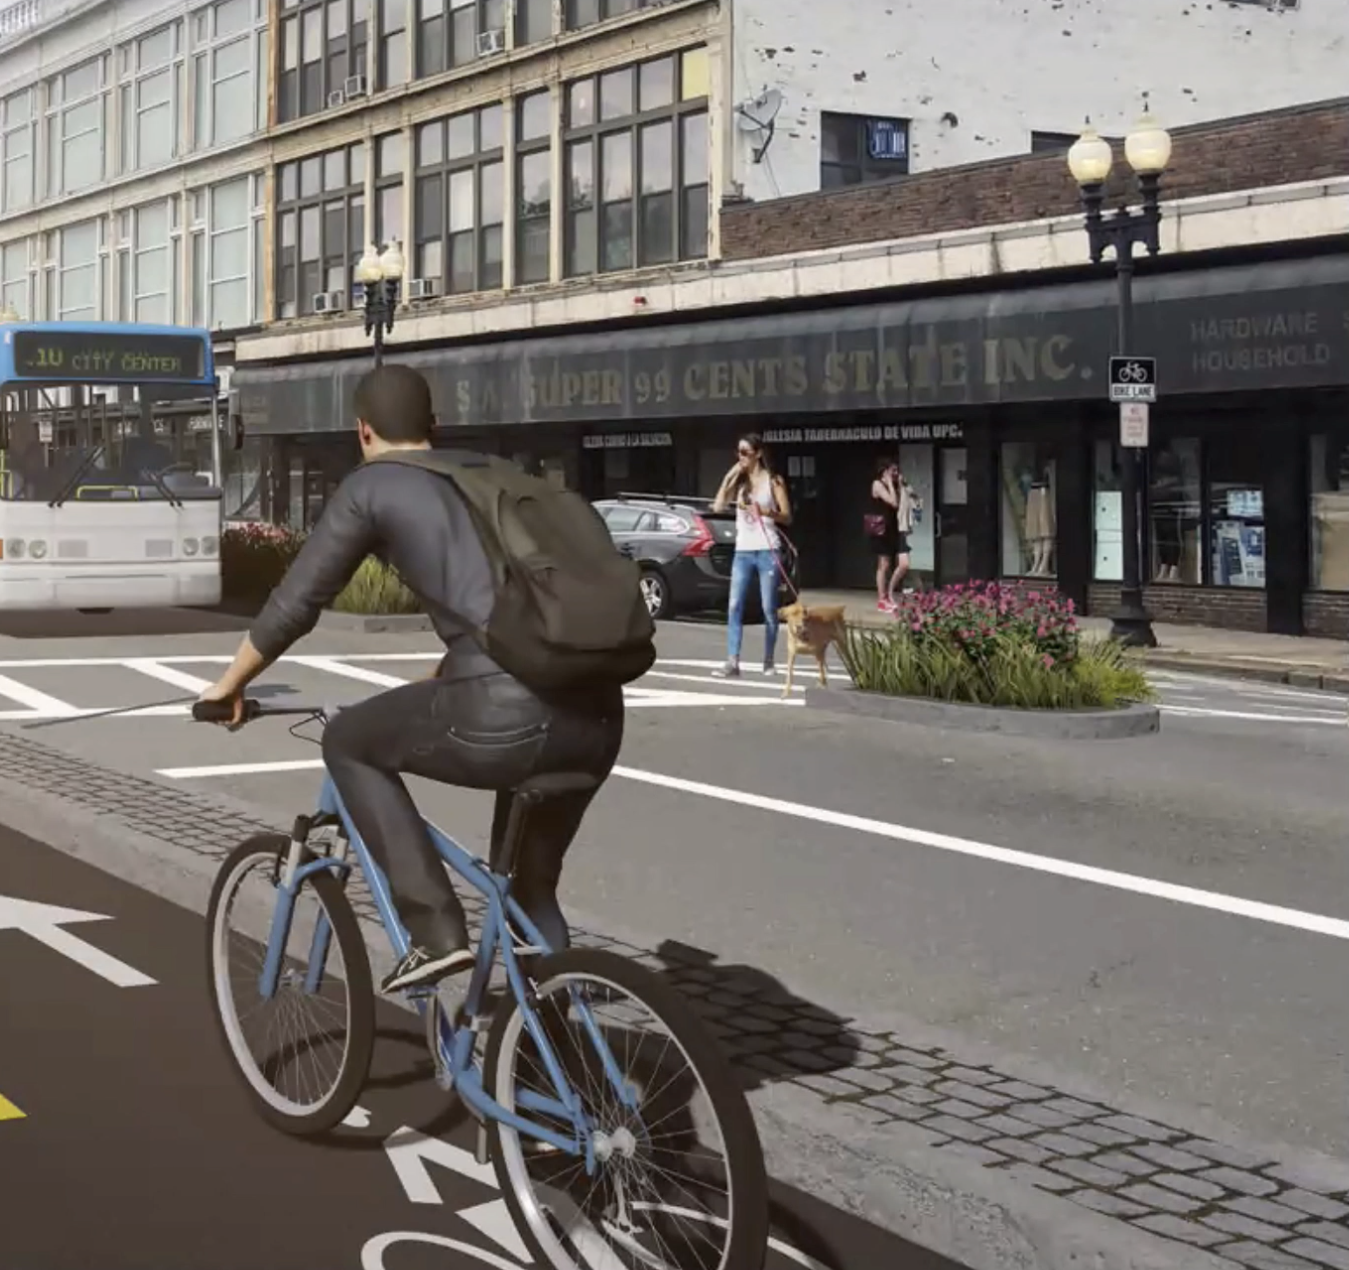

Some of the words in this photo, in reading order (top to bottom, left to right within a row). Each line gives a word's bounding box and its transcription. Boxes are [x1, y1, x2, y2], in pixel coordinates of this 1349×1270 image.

[1190, 312, 1318, 341] HARDWARE
[72, 351, 114, 371] CITY
[121, 353, 182, 372] CENTER
[634, 369, 671, 404] 99
[683, 356, 808, 400] CENTS
[822, 342, 967, 393] STATE
[983, 334, 1093, 385] INC.
[1192, 343, 1331, 373] HOUSEHOLD
[762, 428, 802, 443] IGLESIA
[884, 426, 900, 440] DE
